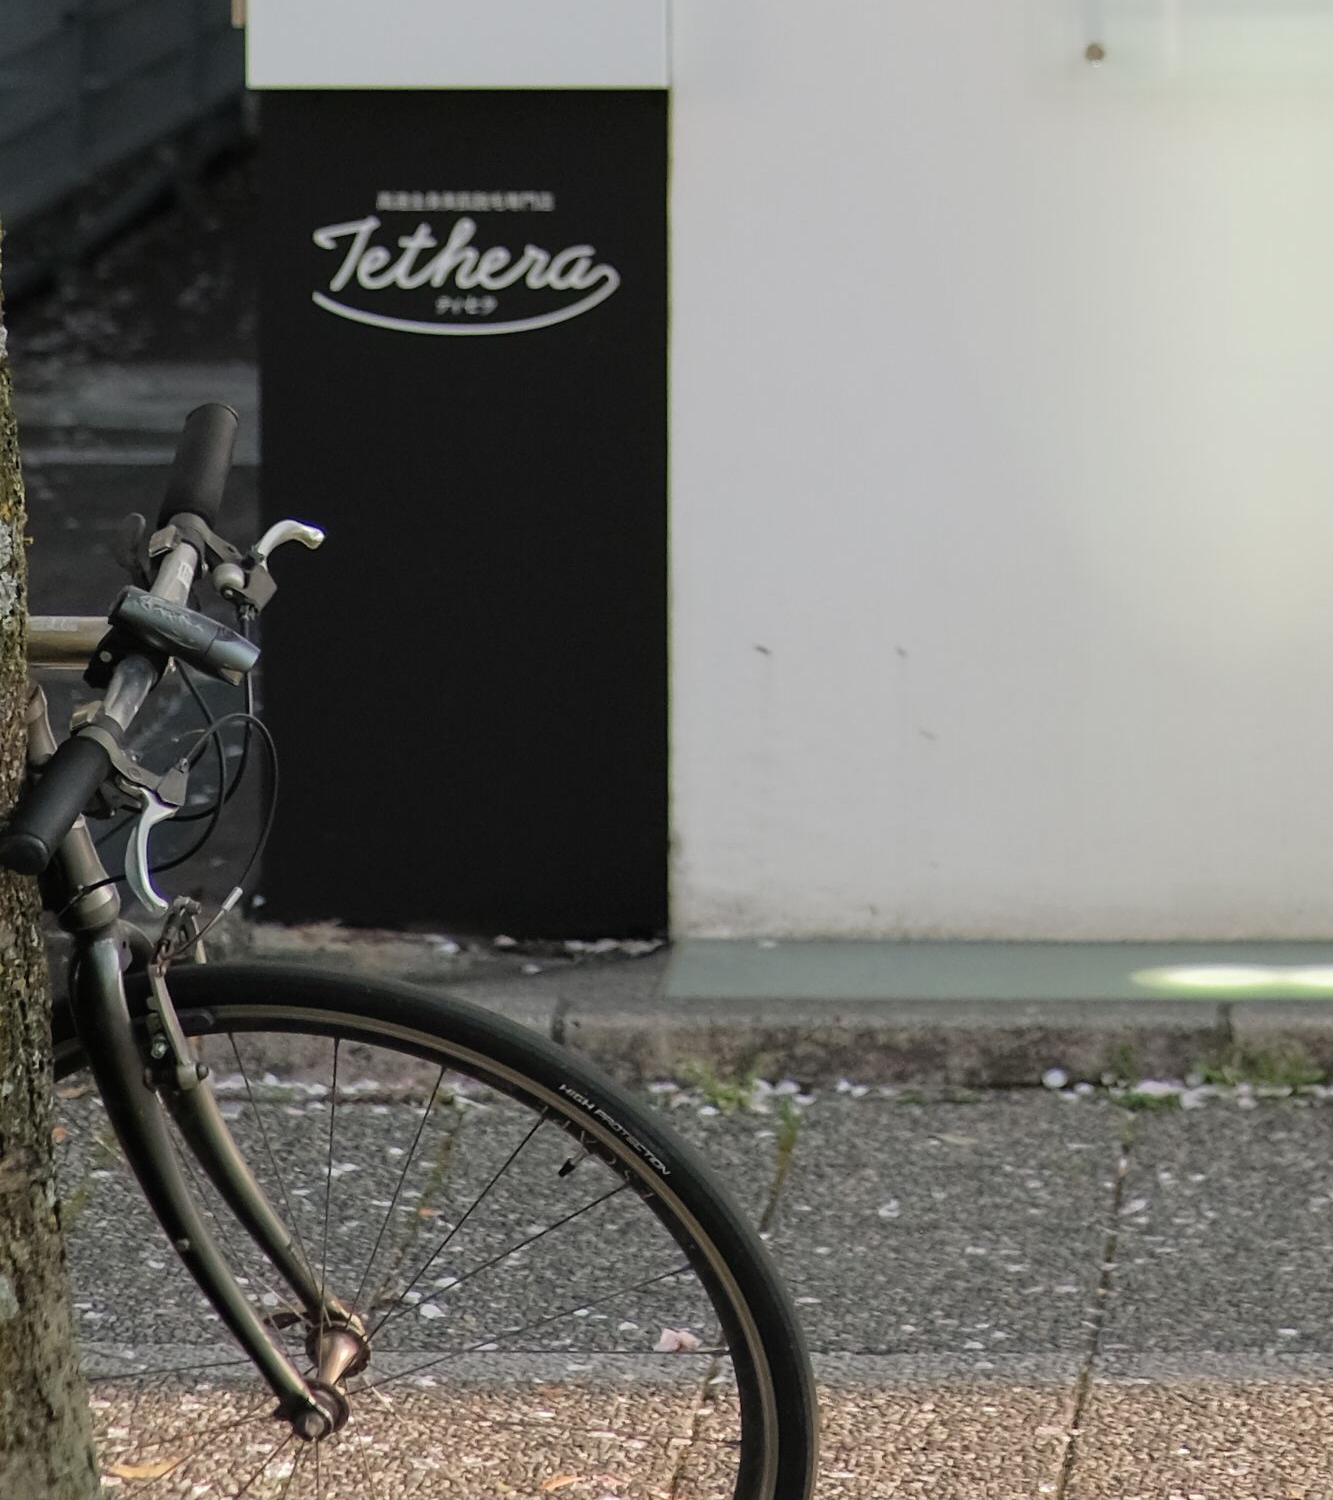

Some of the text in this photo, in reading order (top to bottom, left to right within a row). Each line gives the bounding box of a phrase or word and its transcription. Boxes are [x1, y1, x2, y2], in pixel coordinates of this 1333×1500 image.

[312, 215, 621, 291] Tethera
[558, 1083, 595, 1109] HIGH
[594, 1109, 671, 1175] PROTECTION
